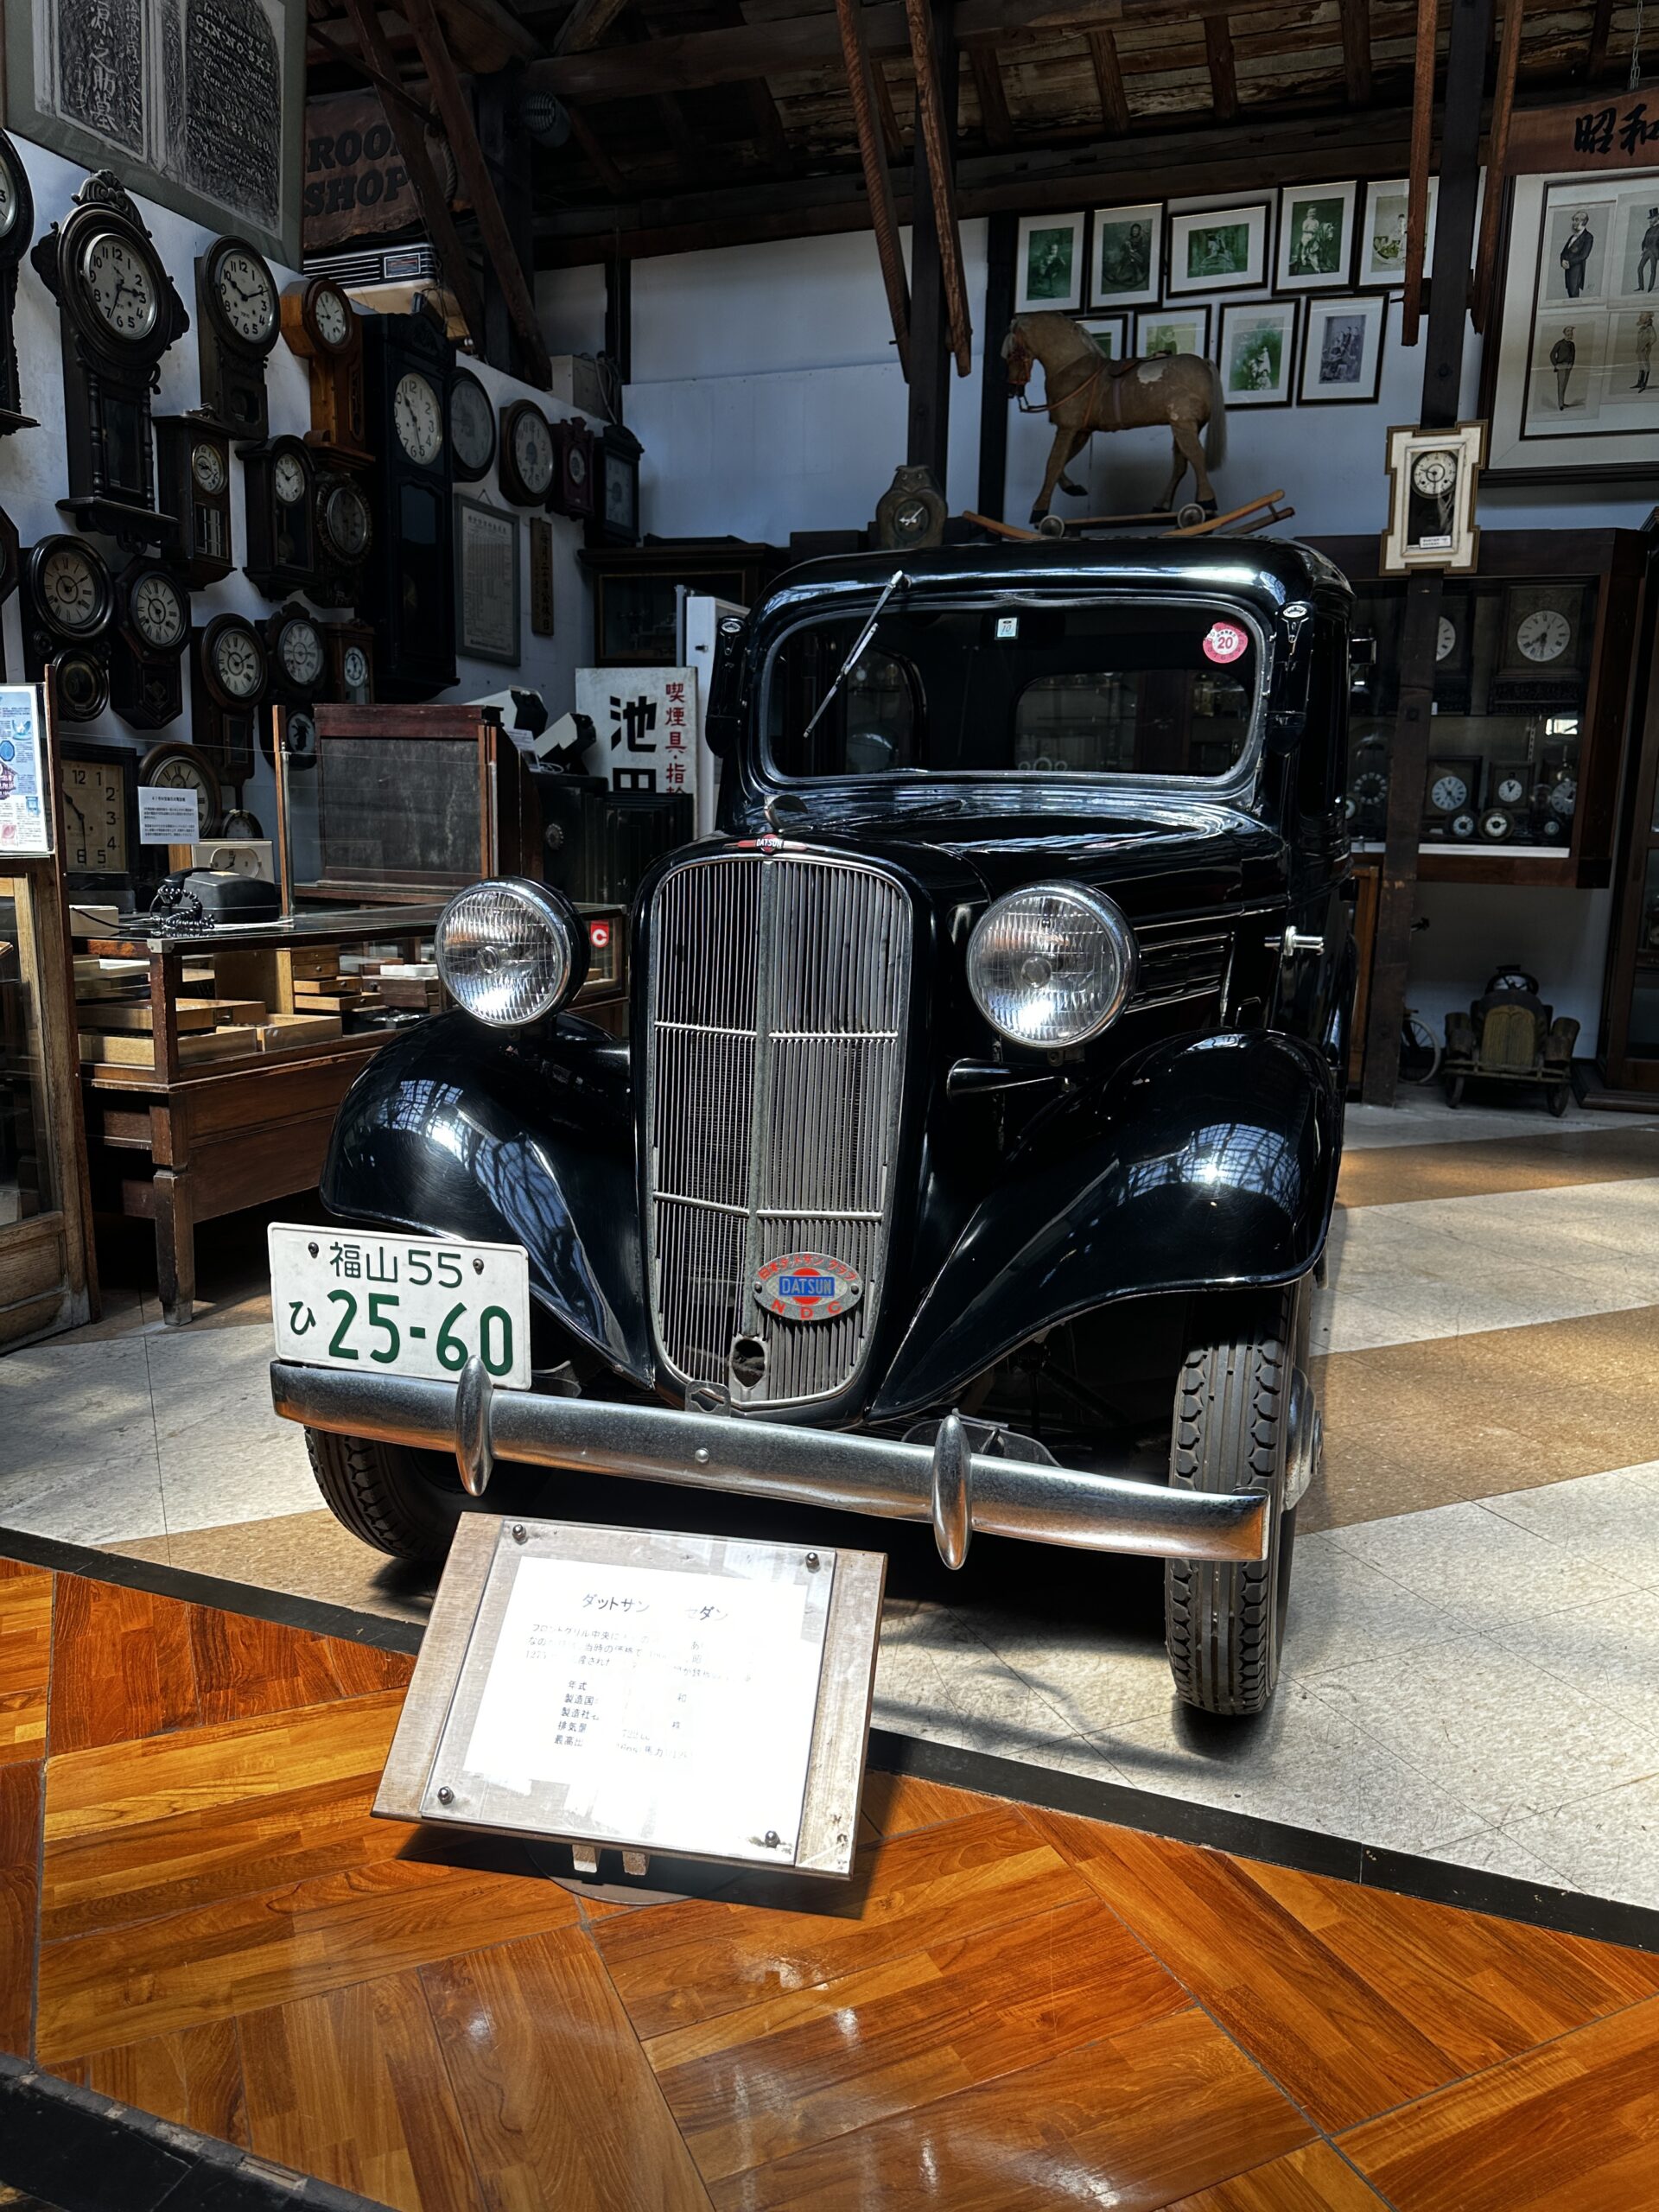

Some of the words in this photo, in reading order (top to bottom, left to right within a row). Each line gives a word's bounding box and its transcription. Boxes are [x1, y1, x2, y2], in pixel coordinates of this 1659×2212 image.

[308, 124, 404, 173] ROO
[305, 166, 413, 218] SHOP
[1217, 636, 1233, 650] 20
[609, 695, 658, 793] 池田
[665, 682, 689, 795] 喫煙具・指
[756, 838, 784, 849] DATSUN
[782, 1278, 832, 1295] DATSUN
[288, 1300, 316, 1336] ひ
[327, 1288, 514, 1376] 25-60
[582, 1592, 651, 1613] ダットサン
